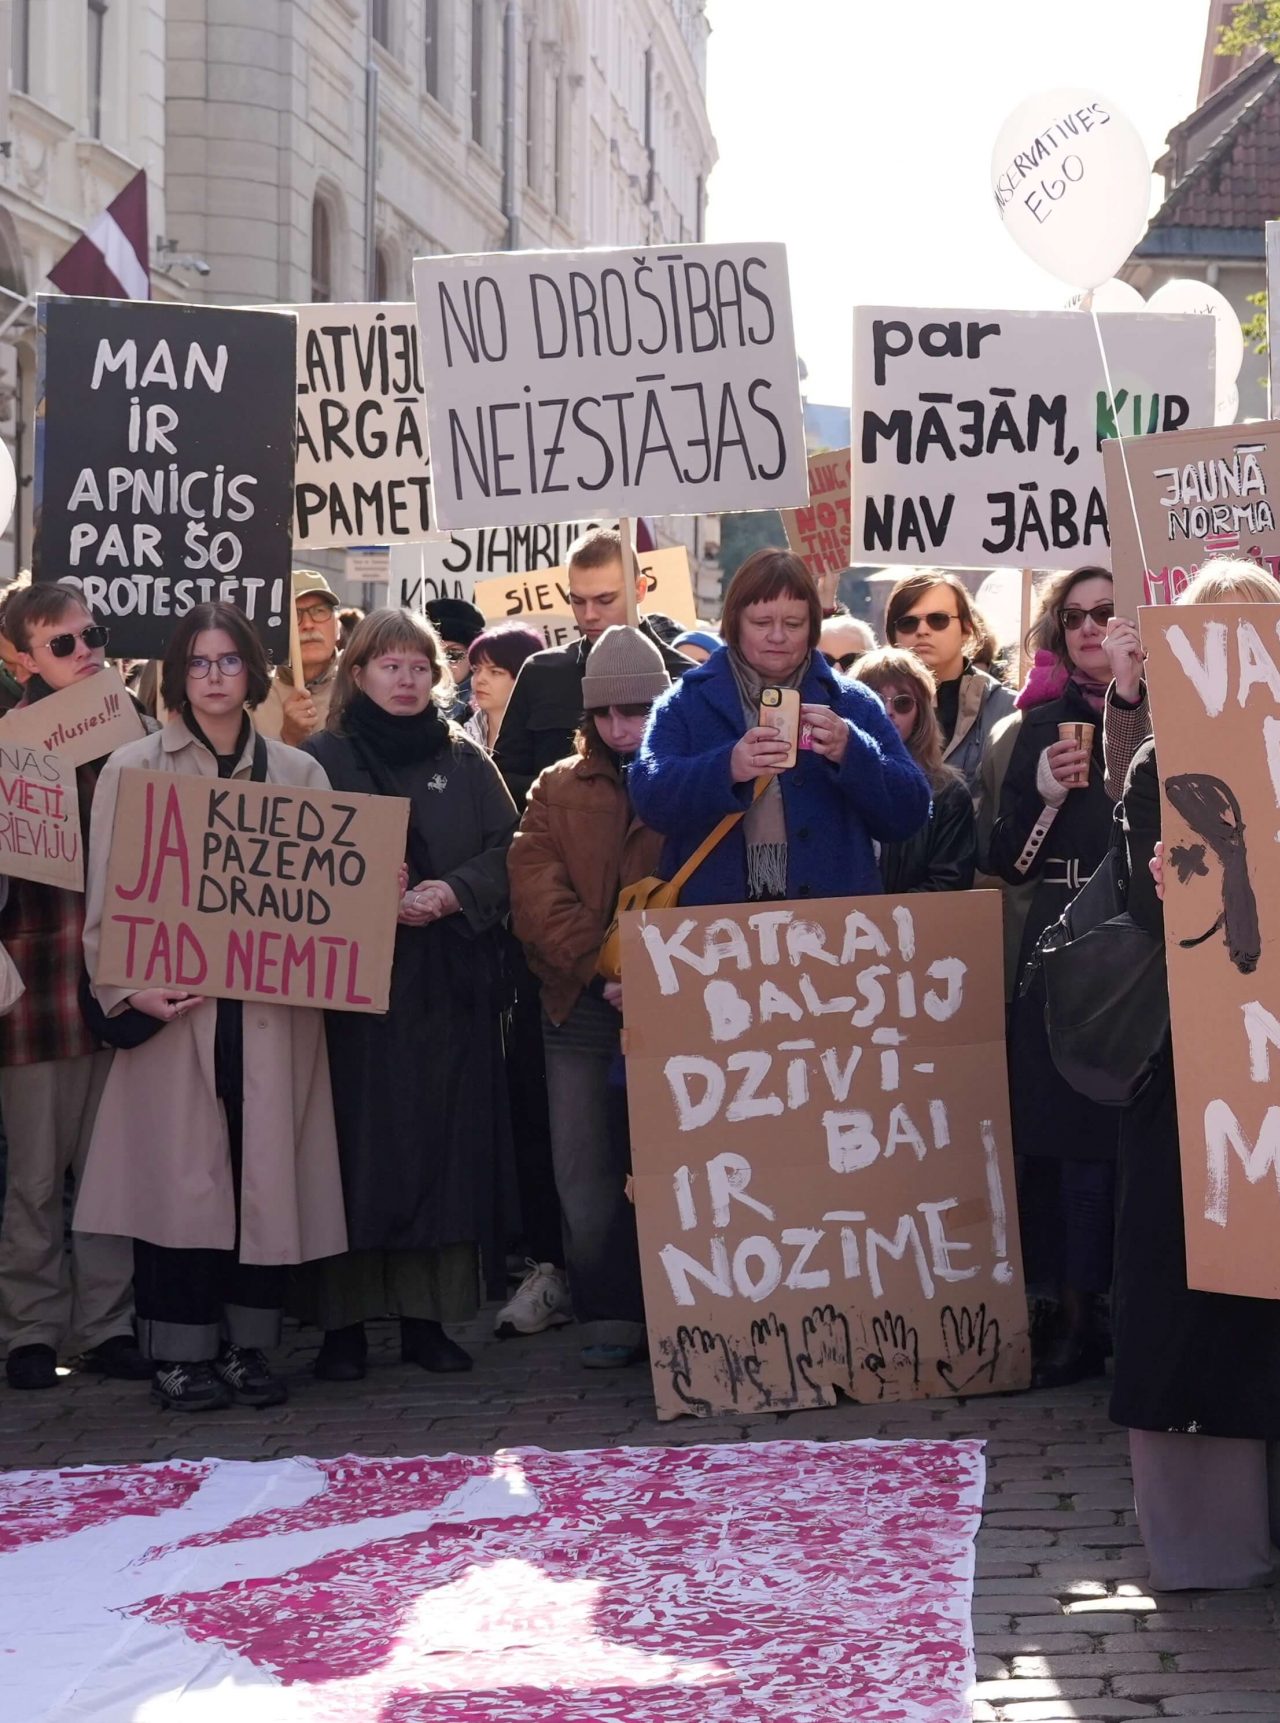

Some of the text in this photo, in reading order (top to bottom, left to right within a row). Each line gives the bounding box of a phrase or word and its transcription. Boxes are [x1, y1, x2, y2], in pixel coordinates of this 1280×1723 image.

[994, 103, 1110, 221] NSERVATIVE'S
[1024, 154, 1084, 224] EGO
[438, 254, 775, 367] NO DROŠĪBAS
[91, 339, 228, 393] MAN
[873, 319, 1000, 386] par
[128, 397, 179, 454] IR
[448, 373, 787, 501] NEIZSTĀJAS
[861, 387, 1079, 465] MĀJĀM,
[67, 463, 258, 522] APNICIS
[1153, 443, 1267, 507] JAUNĀ
[69, 521, 243, 573] PAR ŠO
[863, 493, 954, 552] NAV
[1168, 500, 1275, 541] NORMA
[115, 782, 190, 907] JA
[208, 789, 357, 847] KLIEDZ
[203, 832, 366, 887] PAZEMO
[198, 875, 331, 925] DRAUD
[111, 915, 208, 986] TAD
[638, 905, 916, 996] KATRAI
[703, 957, 968, 1042] BALSIJ
[663, 1027, 935, 1131] DZĪVĪ-
[822, 1100, 951, 1174] BAI
[658, 1118, 1013, 1306] NOZĪME!
[673, 1152, 776, 1230] IR
